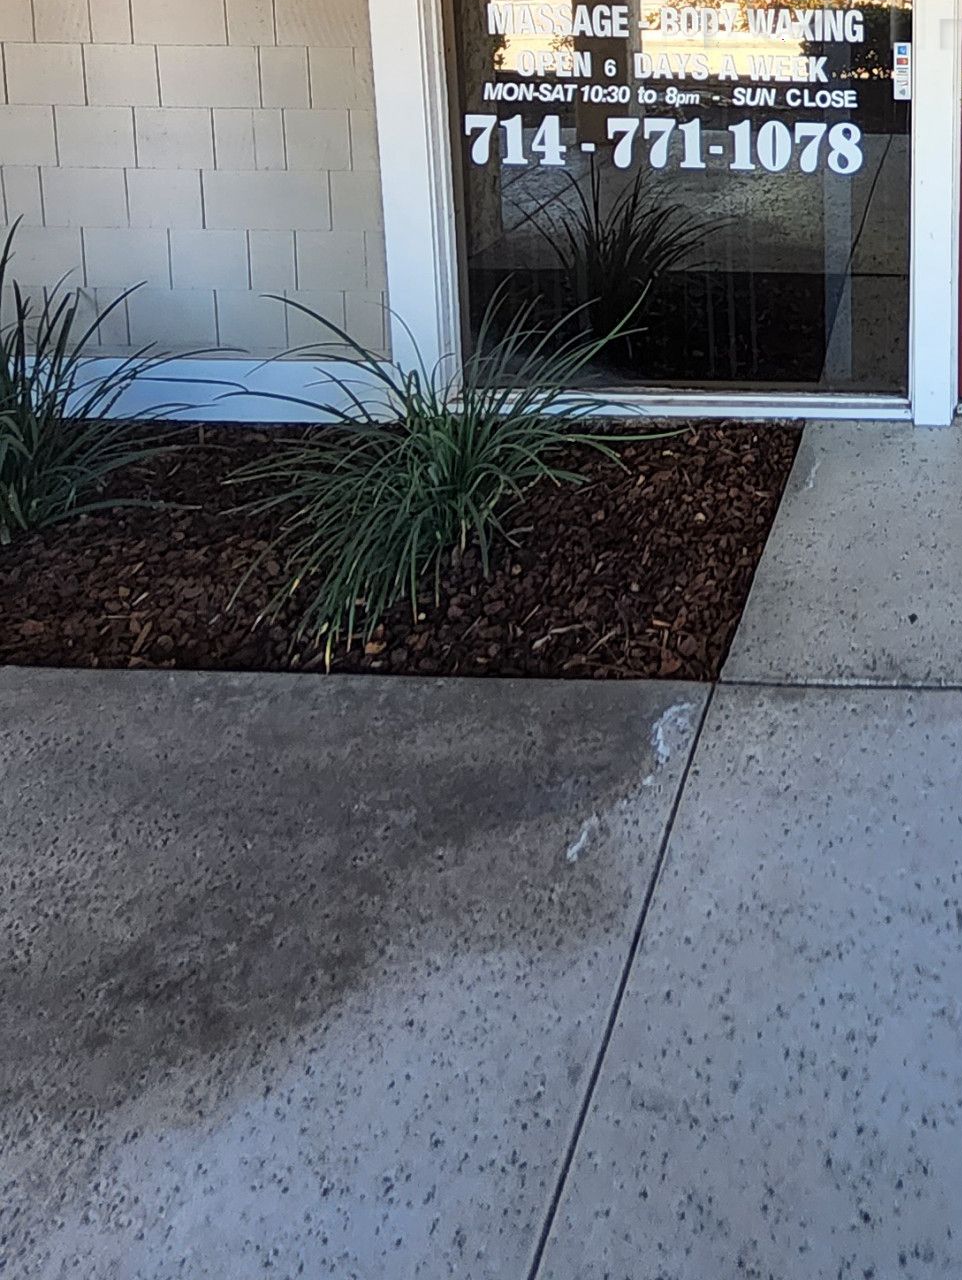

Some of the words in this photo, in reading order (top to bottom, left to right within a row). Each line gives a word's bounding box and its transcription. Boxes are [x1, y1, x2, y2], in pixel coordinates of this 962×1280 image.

[487, 2, 630, 37] MASSAGE
[660, 6, 740, 38] BODY
[746, 7, 864, 42] WAXING
[516, 50, 591, 78] OPEN
[604, 59, 616, 77] 6
[634, 52, 708, 80] DAYS
[718, 54, 738, 81] A
[749, 55, 828, 83] WEEK
[483, 82, 577, 102] MON-SAT
[581, 84, 630, 104] 10:30
[637, 85, 656, 104] to
[665, 88, 700, 107] 8pm
[733, 88, 776, 107] SUN
[786, 90, 858, 108] CLOSE
[464, 114, 566, 166] 714
[607, 117, 864, 174] 771-1078
